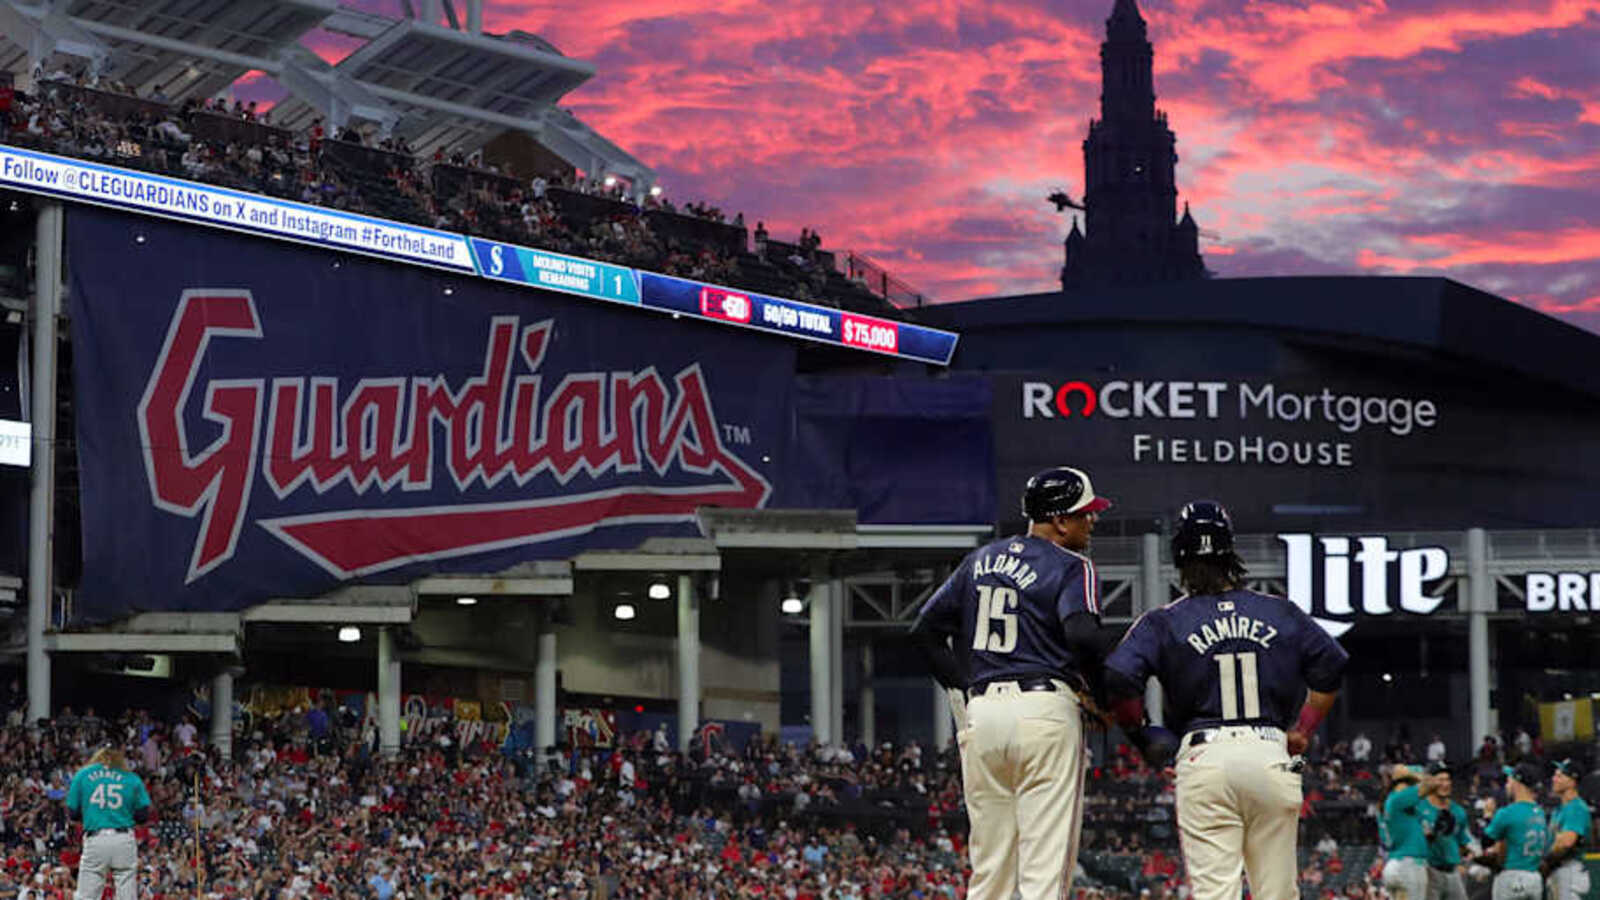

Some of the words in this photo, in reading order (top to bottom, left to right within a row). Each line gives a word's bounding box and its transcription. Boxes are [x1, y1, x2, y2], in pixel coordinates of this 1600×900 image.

[4, 156, 58, 185] Follow
[63, 167, 209, 214] @CLEGUARDIANS
[213, 200, 232, 218] on
[236, 202, 246, 219] X
[250, 207, 278, 227] and
[282, 210, 357, 242] Instagram
[362, 231, 455, 260] #FortheLand
[614, 274, 622, 295] 1
[799, 310, 832, 334] TOTAL
[844, 319, 896, 349] $75,000
[1022, 381, 1227, 418] ROCKET
[1239, 383, 1437, 435] Mortgage
[136, 288, 770, 584] Guardians
[974, 553, 1038, 590] ALOMAR
[973, 585, 1018, 653] 15
[1187, 611, 1278, 655] RAMÍREZ
[1213, 652, 1260, 720] 11
[89, 783, 123, 809] 45
